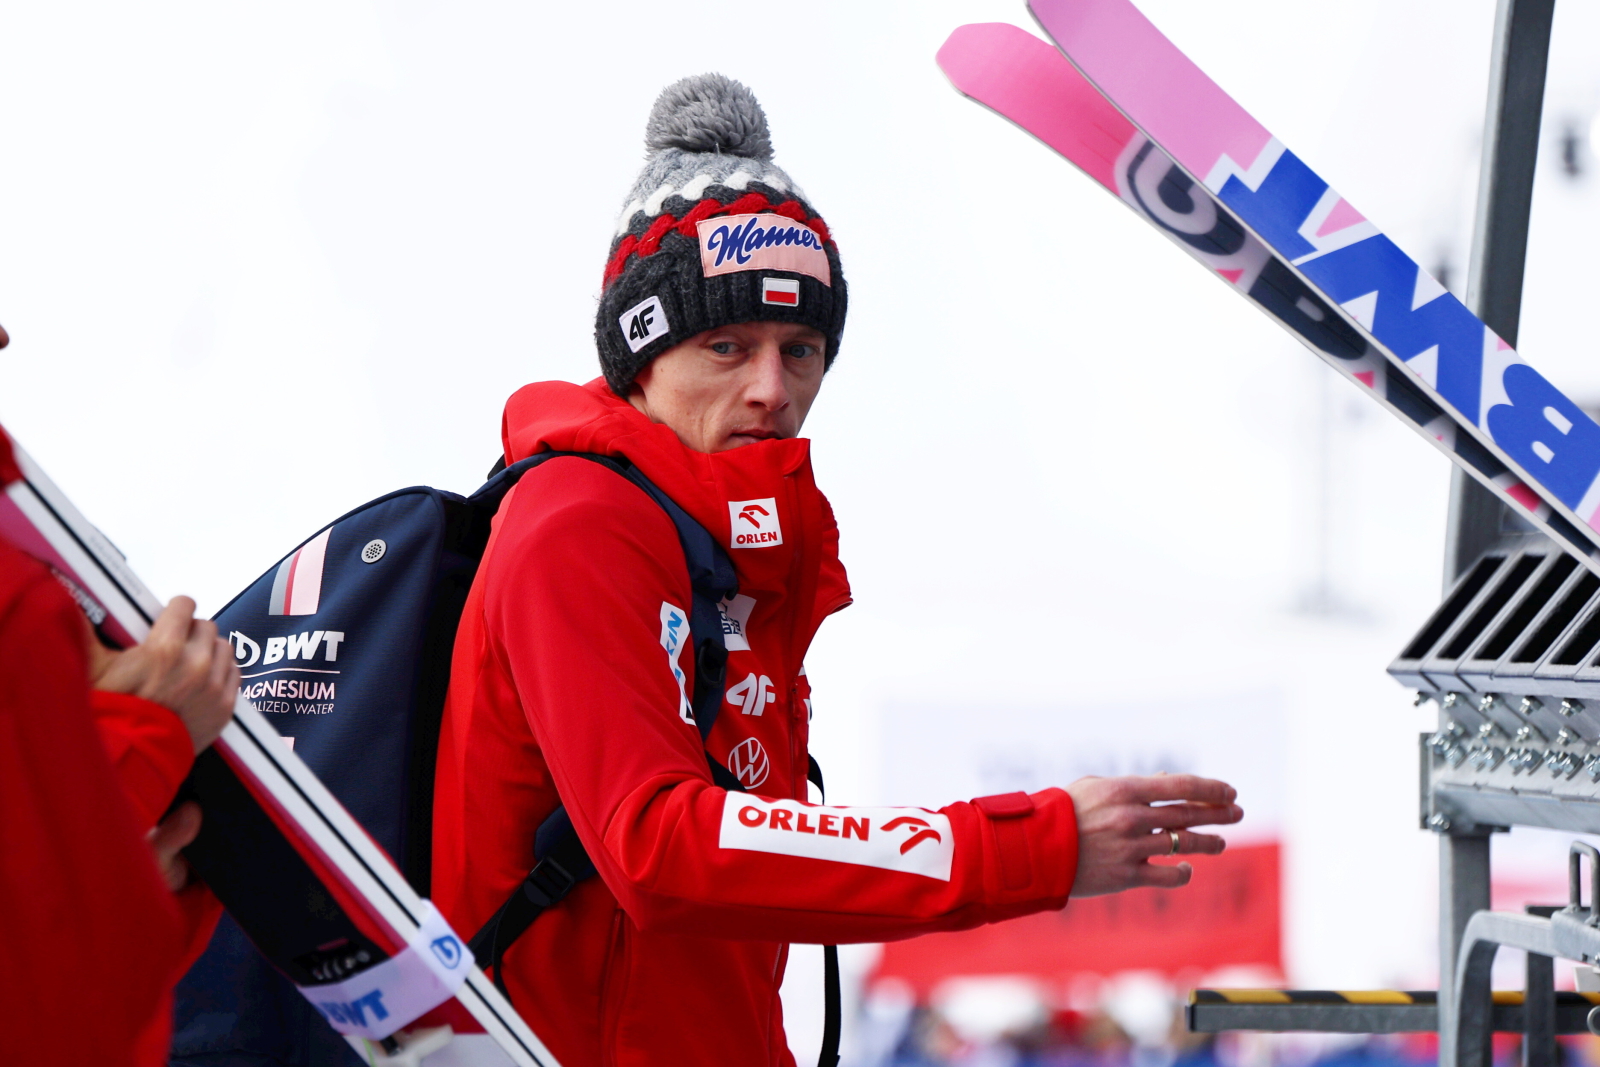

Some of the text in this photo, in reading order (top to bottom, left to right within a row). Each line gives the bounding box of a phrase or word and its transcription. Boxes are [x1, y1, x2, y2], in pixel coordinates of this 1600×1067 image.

[707, 217, 821, 267] Manner
[629, 305, 655, 342] 4F
[736, 531, 778, 545] ORLEN
[263, 631, 345, 665] BWT
[252, 701, 334, 714] ALIZED WATER
[726, 673, 776, 716] 4F
[738, 806, 870, 841] ORLEN
